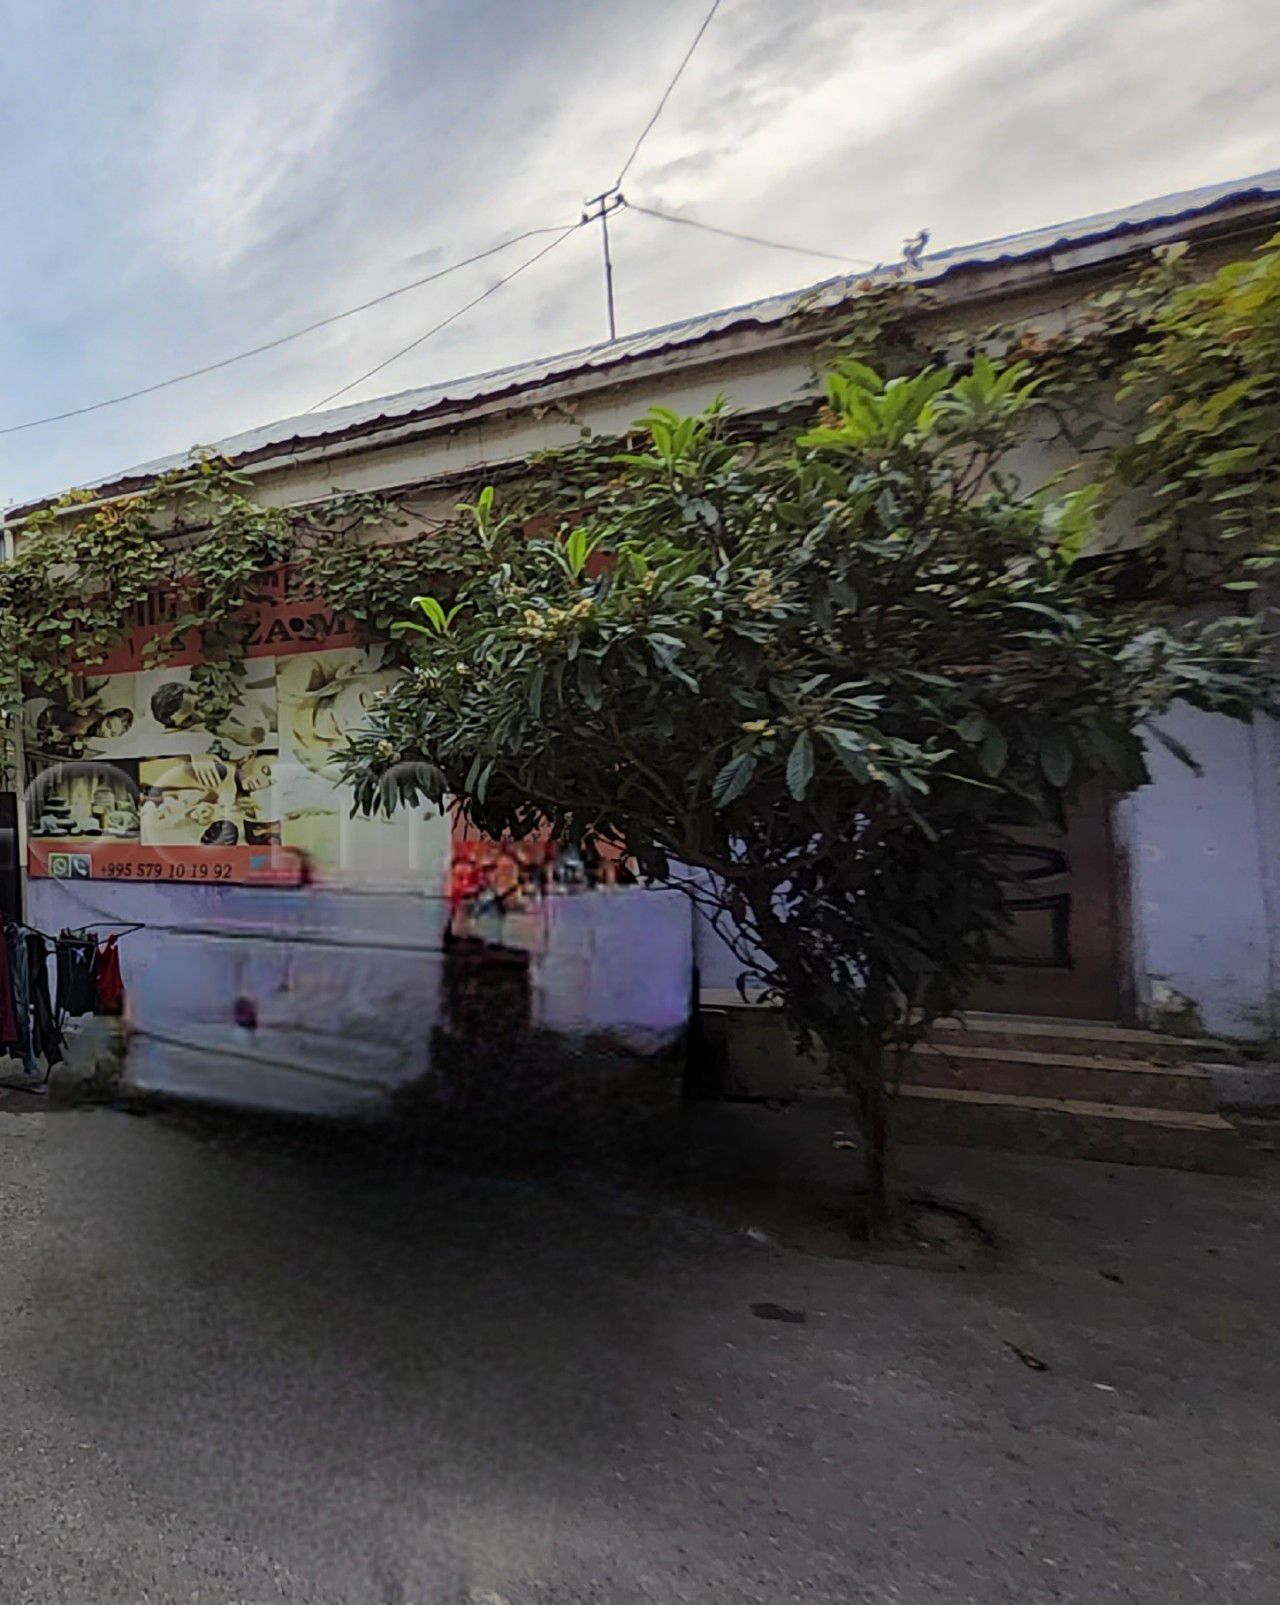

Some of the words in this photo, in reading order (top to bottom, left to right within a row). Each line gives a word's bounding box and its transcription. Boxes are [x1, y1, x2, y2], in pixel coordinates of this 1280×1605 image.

[100, 863, 132, 876] +995
[136, 864, 163, 878] 579
[168, 864, 186, 878] 10
[191, 864, 208, 878] 19
[213, 864, 232, 879] 92
